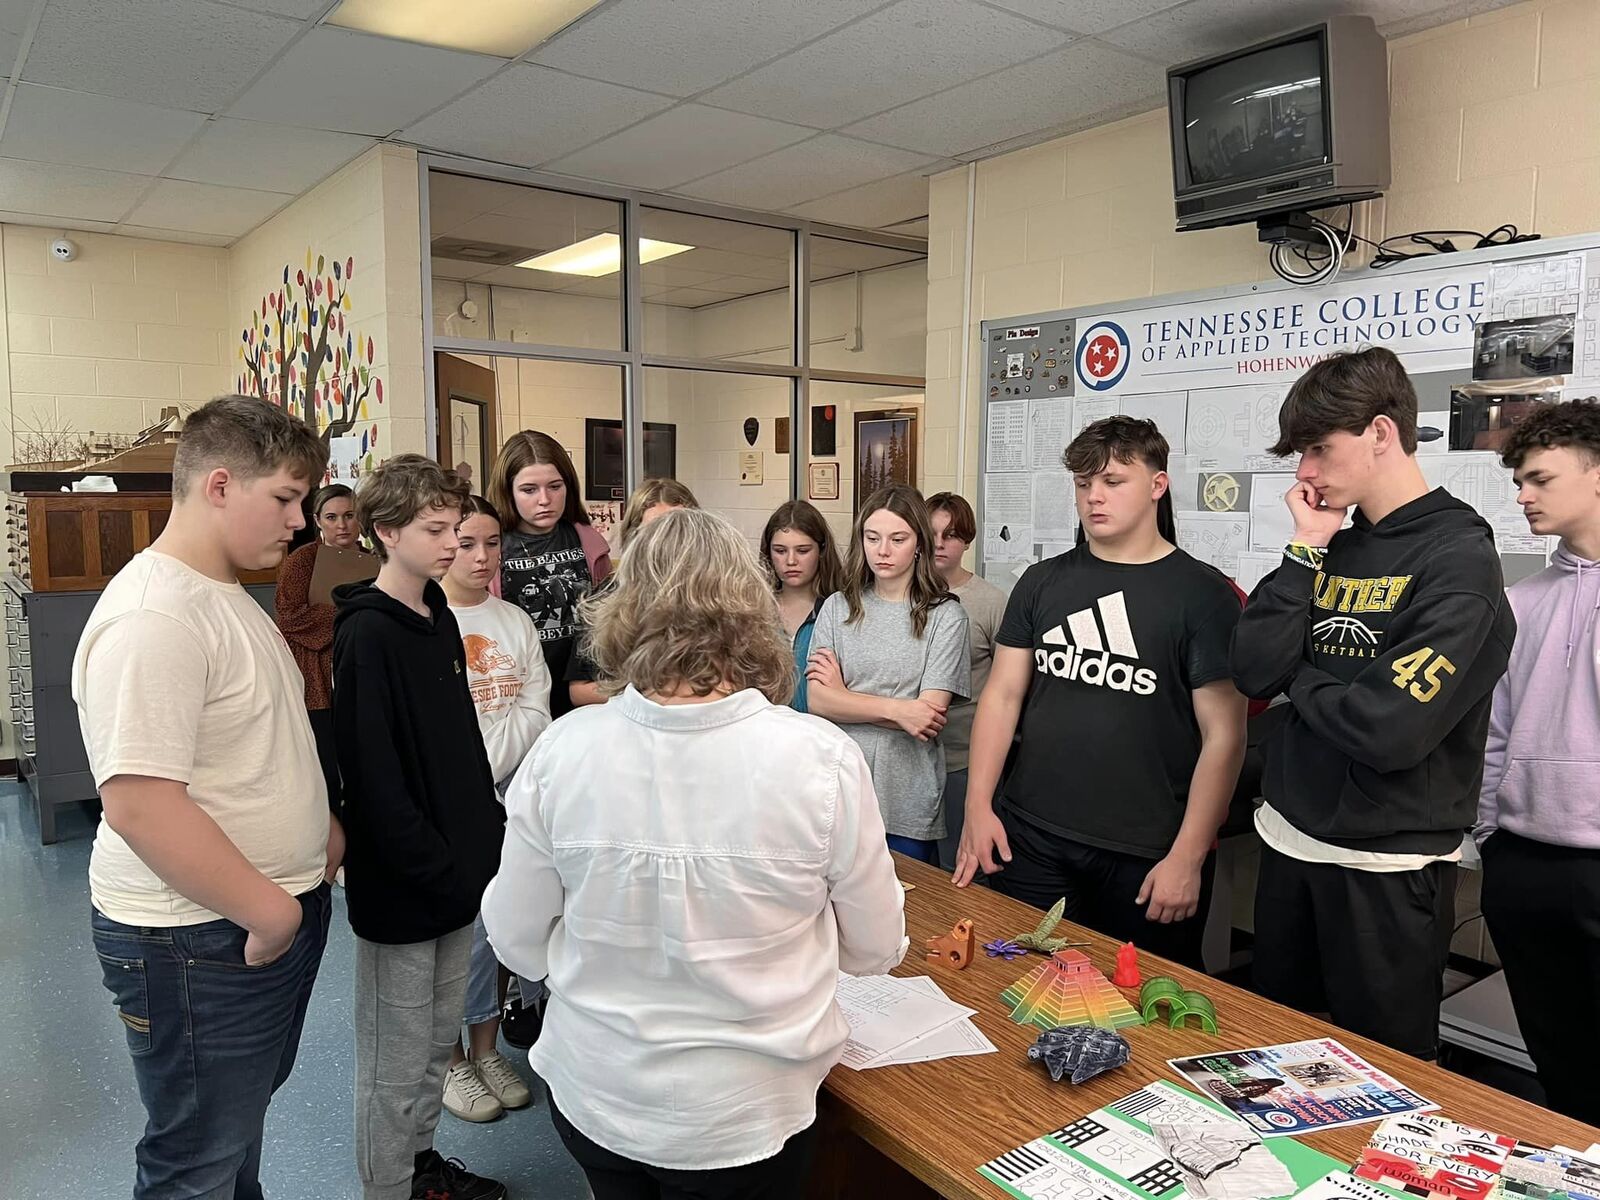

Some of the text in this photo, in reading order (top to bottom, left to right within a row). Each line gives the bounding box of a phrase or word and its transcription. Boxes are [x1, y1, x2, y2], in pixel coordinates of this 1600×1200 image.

[1143, 282, 1485, 344] TENNESSEE COLLEGE
[1142, 313, 1482, 363] OF APPLIED TECHNOLOGY
[1237, 353, 1341, 374] HOHENWA
[505, 548, 585, 570] THE BEATLES
[1313, 571, 1414, 614] ANTHER
[538, 626, 566, 640] BEY
[1314, 643, 1377, 658] SKETBAL
[1035, 644, 1157, 695] adidas
[1391, 646, 1456, 703] 45
[1265, 1089, 1322, 1125] UNDERWAY
[1278, 1086, 1334, 1123] EXPANSION
[1303, 1090, 1349, 1120] BUILDING
[1358, 1083, 1407, 1108] NEW
[1376, 1133, 1434, 1150] SHADE
[1441, 1143, 1466, 1154] OF
[1403, 1114, 1491, 1141] HERE IS A
[1033, 1141, 1138, 1200] HORIZONTAL SYMMET
[1382, 1142, 1422, 1161] FOR
[1429, 1156, 1494, 1180] EVERY
[1384, 1166, 1452, 1195] woman
